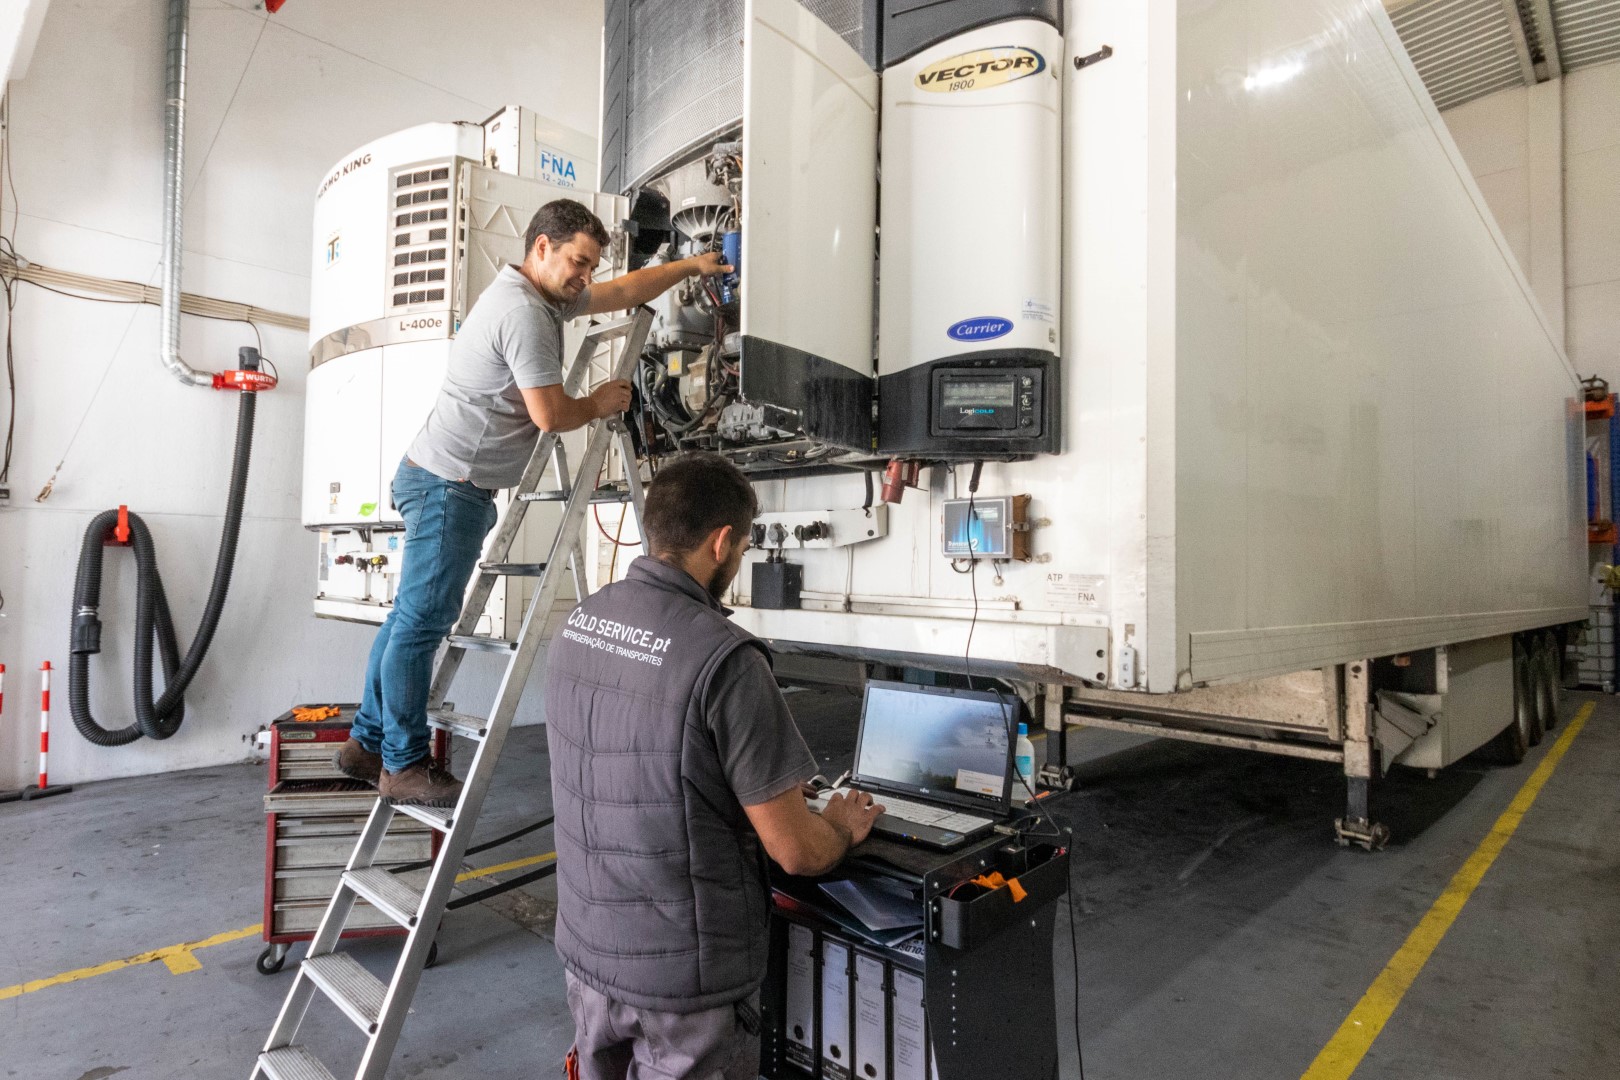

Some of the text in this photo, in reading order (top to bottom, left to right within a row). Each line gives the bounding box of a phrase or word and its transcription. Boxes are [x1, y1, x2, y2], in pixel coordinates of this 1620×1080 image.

[918, 56, 1035, 86] VECTOR
[948, 78, 975, 92] 1800
[343, 153, 371, 176] KING
[541, 150, 576, 181] FNA
[542, 172, 551, 182] 12
[400, 318, 442, 331] L-400e
[956, 322, 1005, 336] Carrier
[971, 537, 979, 551] 2
[1047, 573, 1063, 582] ATP
[1078, 592, 1096, 602] FNA
[596, 619, 671, 653] SERVICE.pt
[562, 628, 663, 667] REFRIGERAÇÃO DE TRANSPORTES
